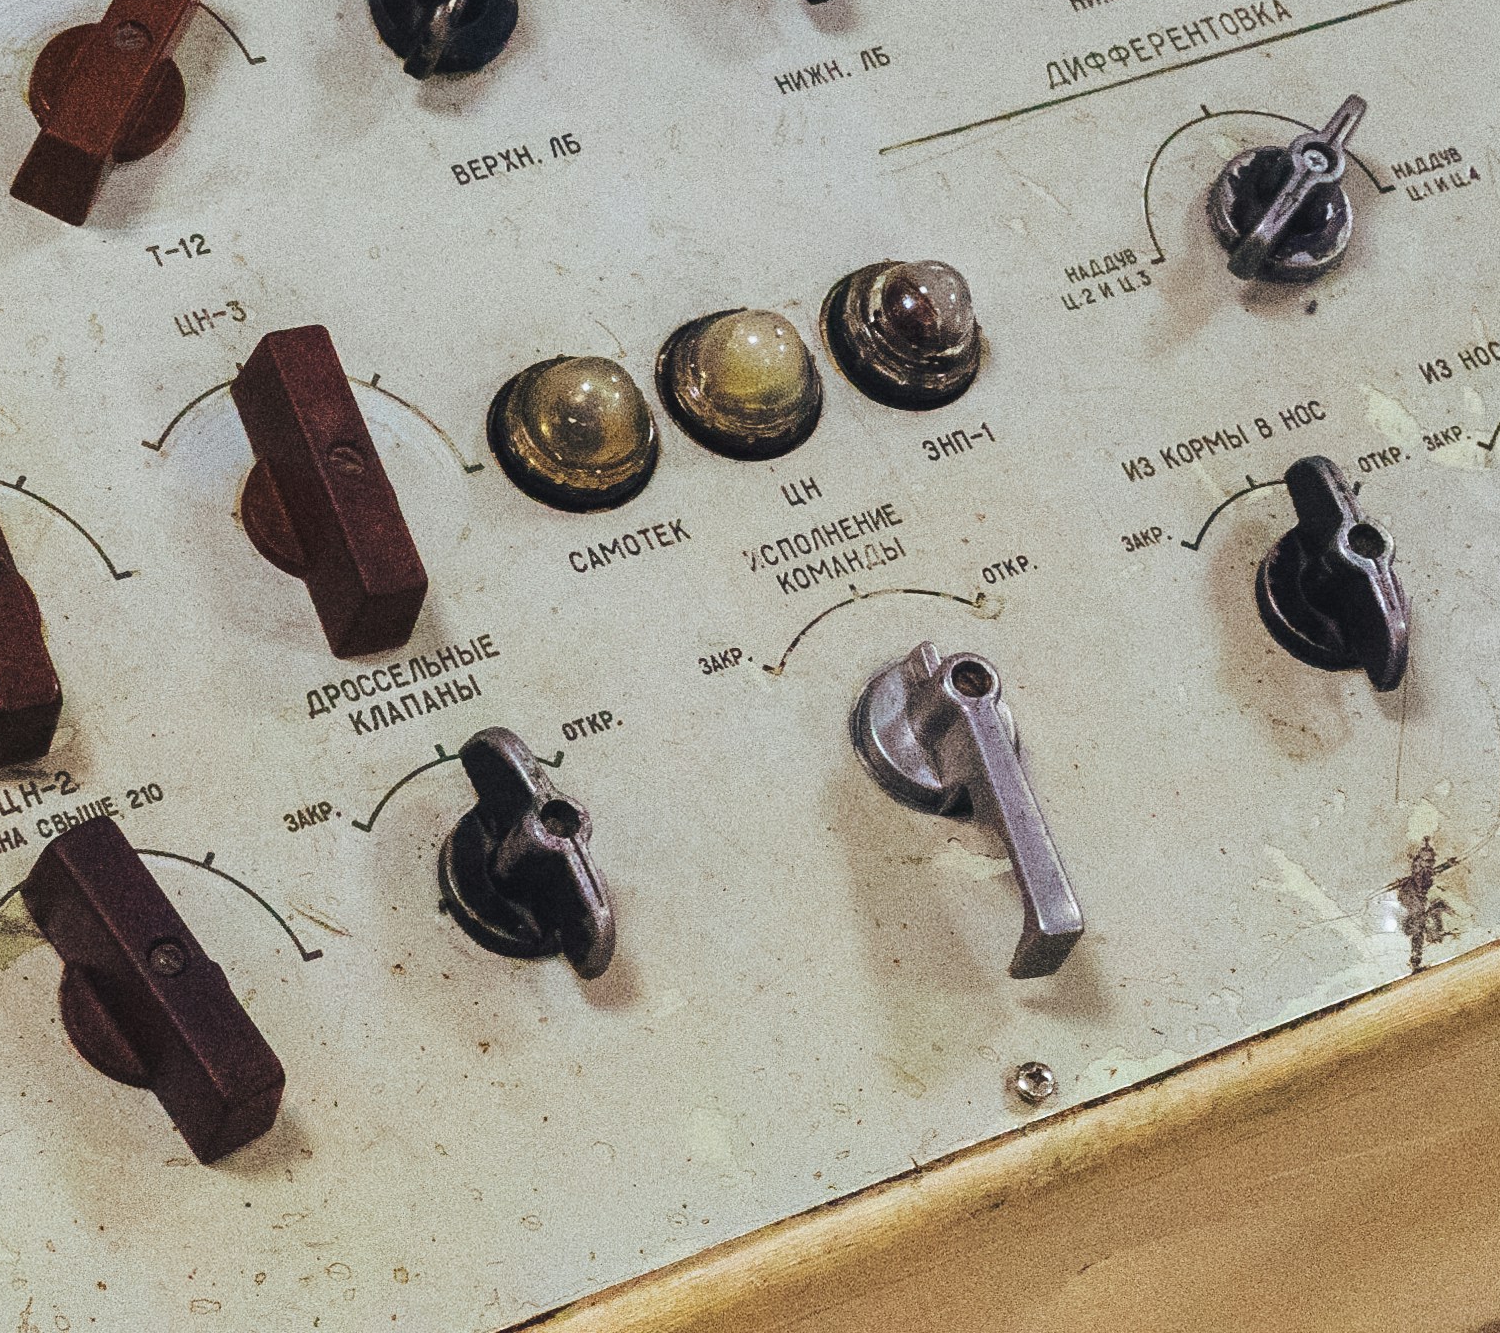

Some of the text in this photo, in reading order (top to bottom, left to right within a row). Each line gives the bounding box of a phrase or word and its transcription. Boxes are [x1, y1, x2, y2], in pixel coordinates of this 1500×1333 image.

[774, 64, 852, 96] НИЖН.
[450, 148, 544, 187] ВЕРХН.
[146, 234, 212, 269] Т-12
[1064, 248, 1138, 285] НАДДУВ
[173, 301, 247, 339] ЦН-3
[1418, 358, 1453, 387] ИЗ
[921, 423, 997, 463] ЭНП-1
[1120, 400, 1328, 484] ИЗ КОРМЫ В НОС
[1422, 425, 1472, 454] ЗАКР.
[1357, 444, 1411, 475] ОТКР.
[780, 476, 823, 508] ЦН
[567, 518, 692, 575] САМОТЕК
[1122, 526, 1172, 555] ЗАКР.
[775, 540, 906, 596] КОМАНДЫ
[980, 556, 1039, 586] ОТКР.
[304, 634, 501, 719] ДРОССЕЛЬНЫЕ
[698, 647, 754, 677] ЗАКР.
[347, 675, 483, 737] КЛАПАНЫ
[561, 711, 624, 742] ОТКР.
[35, 798, 120, 837] СВЫШЕ
[126, 783, 164, 811] 210
[282, 801, 343, 835] ЗАКР.
